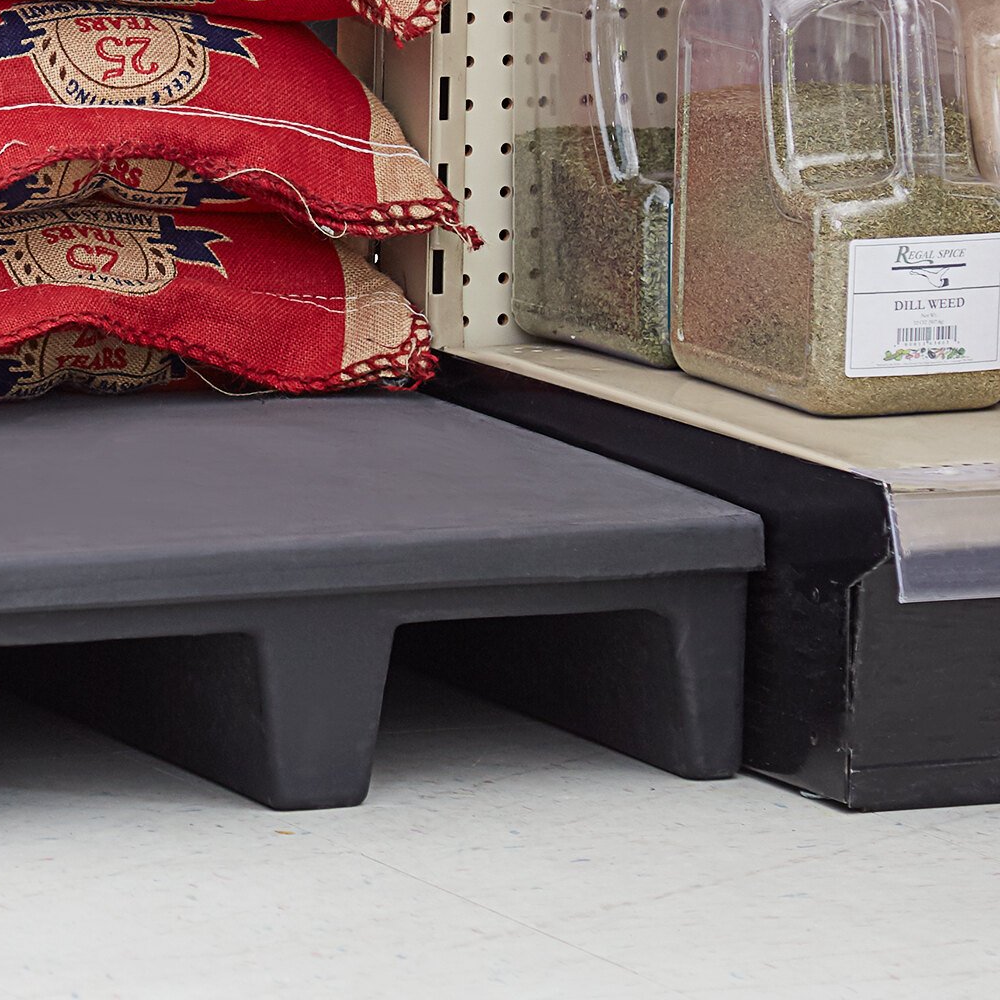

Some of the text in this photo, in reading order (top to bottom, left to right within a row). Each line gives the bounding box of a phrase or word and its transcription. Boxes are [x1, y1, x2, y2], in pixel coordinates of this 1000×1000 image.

[75, 16, 161, 33] YEARS
[95, 36, 159, 82] 25
[42, 223, 125, 248] YEARS
[894, 245, 967, 265] REGAL SPICE
[894, 297, 965, 311] DILL WEED
[55, 348, 127, 371] YEARS
